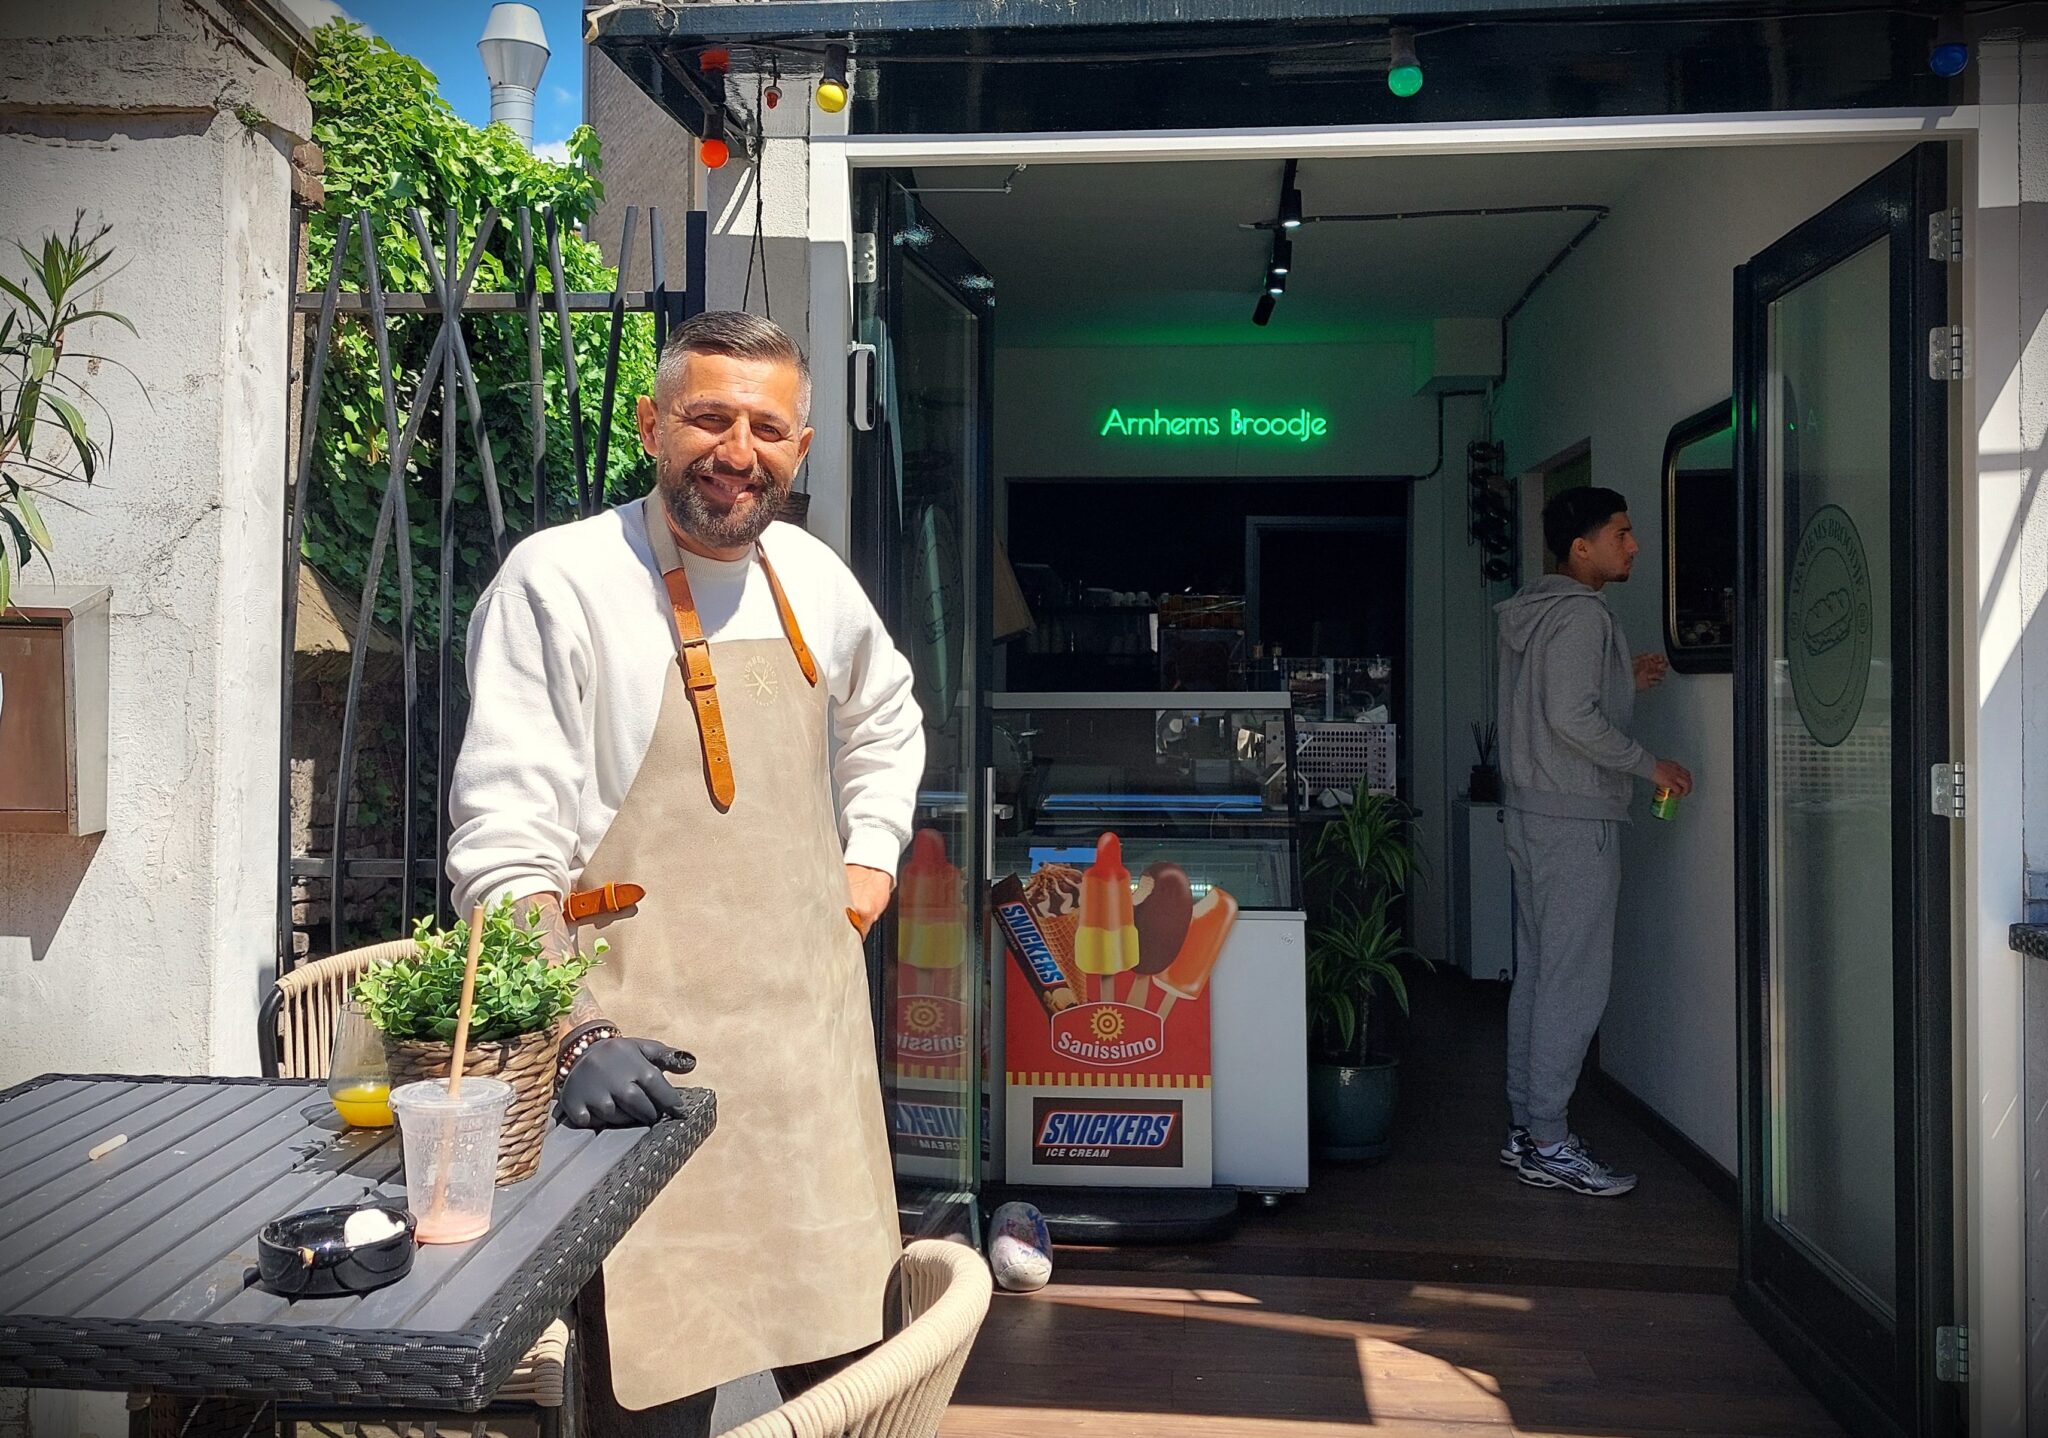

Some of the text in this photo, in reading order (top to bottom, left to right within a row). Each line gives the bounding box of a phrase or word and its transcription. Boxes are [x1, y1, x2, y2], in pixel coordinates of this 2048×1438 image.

[1101, 408, 1327, 442] Arnhems Broodje
[1000, 904, 1065, 984] SNICKERS
[1058, 1032, 1157, 1060] Sanissimo
[1043, 1113, 1173, 1146] SNICKERS
[1046, 1148, 1110, 1159] ICE CREAM
